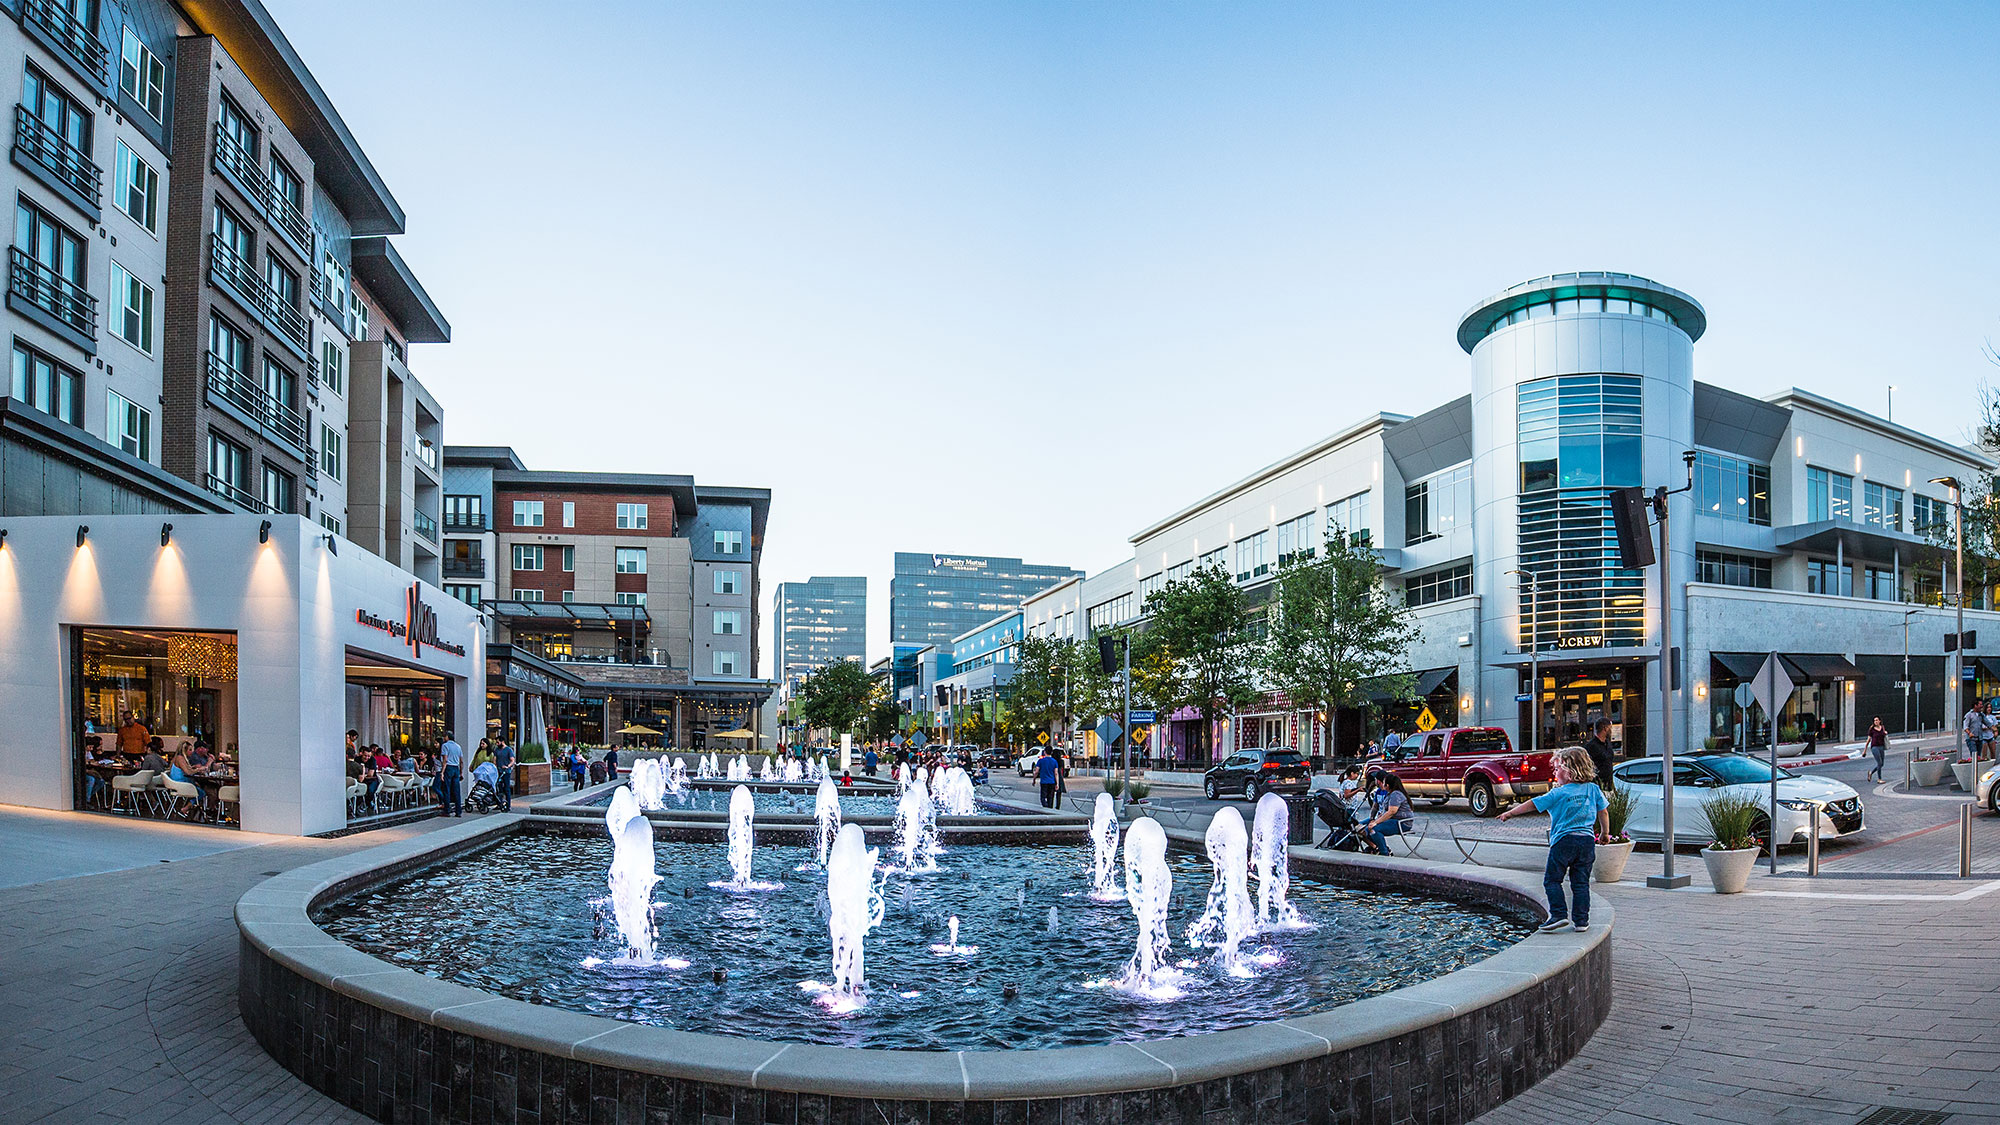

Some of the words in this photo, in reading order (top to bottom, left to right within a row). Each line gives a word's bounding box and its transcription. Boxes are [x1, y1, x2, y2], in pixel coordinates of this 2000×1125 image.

[943, 558, 964, 568] Liberty
[966, 560, 987, 568] Mutual
[1559, 636, 1601, 648] J.CREW
